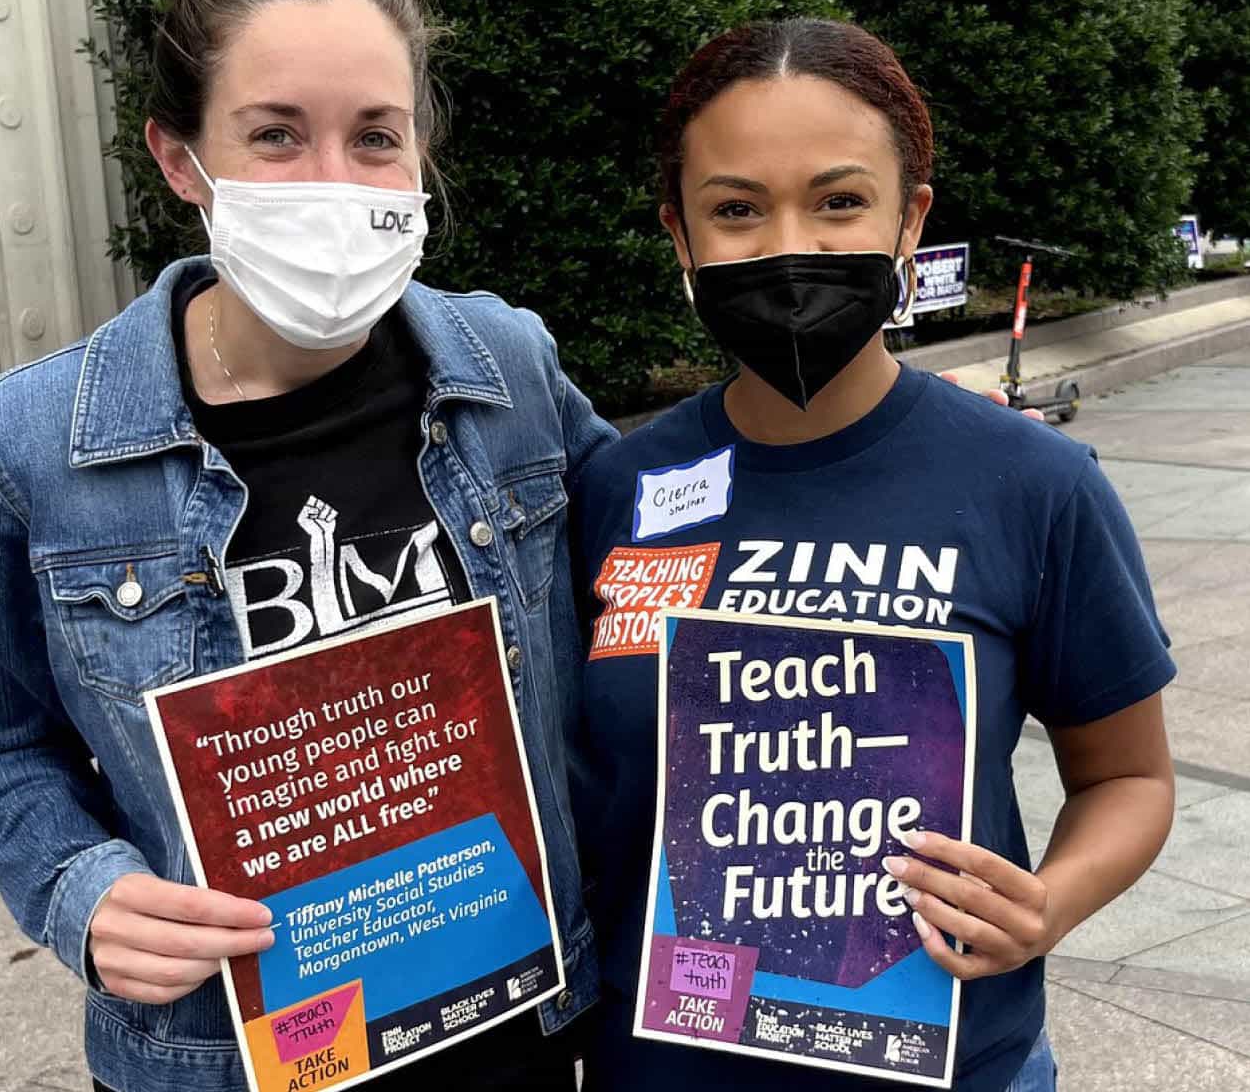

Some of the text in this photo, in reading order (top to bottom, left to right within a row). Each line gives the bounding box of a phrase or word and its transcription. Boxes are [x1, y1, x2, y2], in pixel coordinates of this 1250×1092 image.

[369, 209, 413, 234] LOVE
[653, 479, 709, 507] Cierra
[608, 554, 706, 584] TEACHING
[727, 540, 959, 595] ZINN
[717, 588, 954, 626] EDUCATION
[595, 610, 661, 648] HISTOR
[707, 638, 877, 704] Teach
[321, 685, 384, 723] truth
[391, 672, 432, 700] our
[218, 700, 437, 793] young people can
[227, 716, 479, 819] imagine and fight for
[235, 754, 463, 848] a new world where
[701, 789, 922, 858] Change
[242, 850, 282, 878] we
[287, 836, 328, 863] are
[333, 813, 376, 847] ALL
[806, 845, 845, 872] the
[286, 839, 497, 929] Tiffany Michelle Patterson,
[723, 865, 908, 921] Future
[291, 861, 485, 946] University Social Studies
[294, 900, 437, 961] Teacher Educator,
[299, 888, 509, 980] Morgantown, West Virginia
[440, 988, 495, 1015] BLACK LIVES
[442, 1004, 478, 1022] MATTER
[678, 994, 718, 1015] TAKE
[443, 1013, 481, 1031] SCHOOL
[665, 1010, 725, 1033] ACTION
[816, 1023, 873, 1040] BLACK LIVES
[294, 1047, 336, 1074] TAKE
[814, 1041, 852, 1055] SCHOOL
[287, 1057, 350, 1092] ACTION
